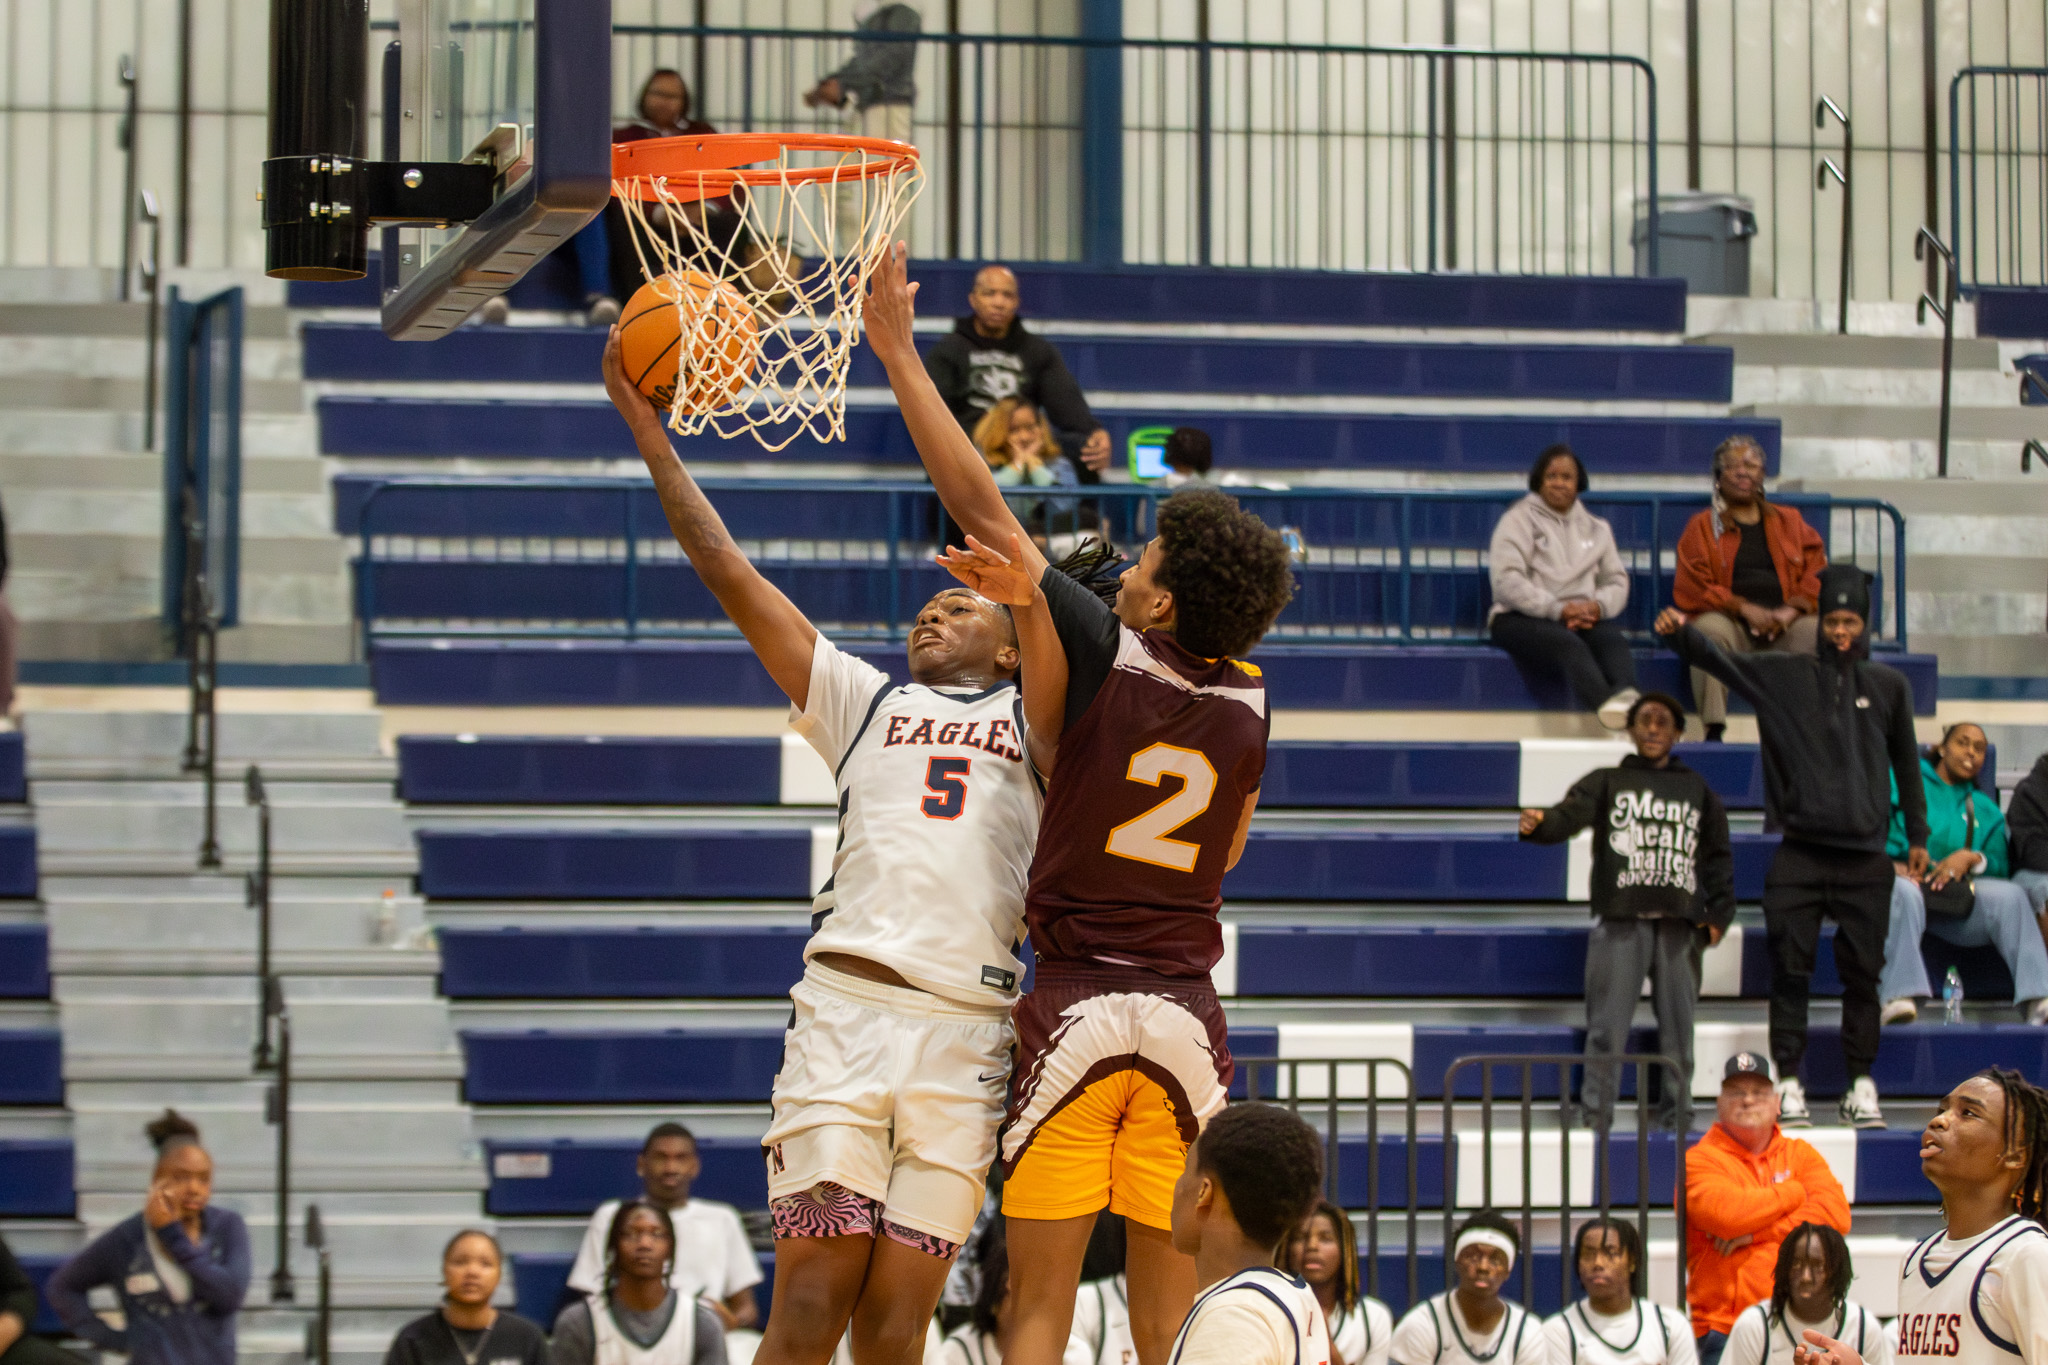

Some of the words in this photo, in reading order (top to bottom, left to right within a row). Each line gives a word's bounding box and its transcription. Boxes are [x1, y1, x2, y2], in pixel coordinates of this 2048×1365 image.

[920, 756, 972, 821] 5
[1105, 741, 1219, 873] 2
[771, 1142, 785, 1176] N
[1898, 1313, 1961, 1357] AGLES
